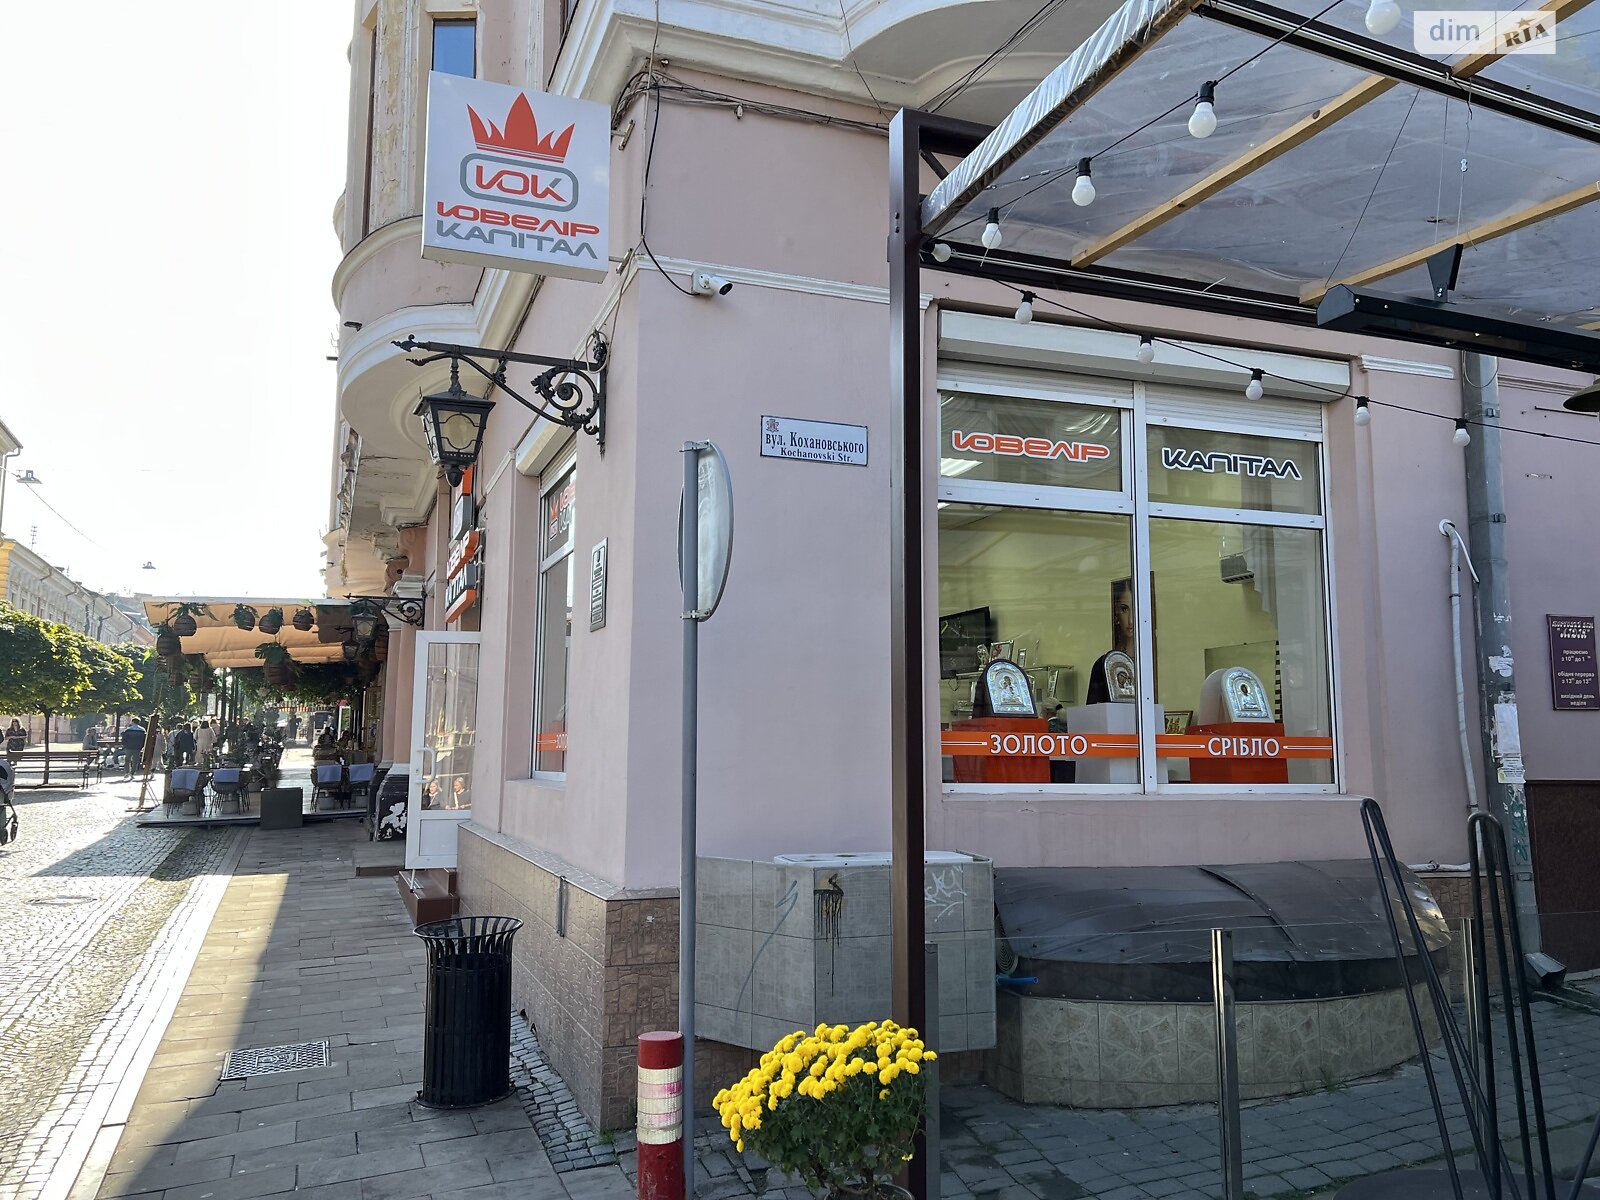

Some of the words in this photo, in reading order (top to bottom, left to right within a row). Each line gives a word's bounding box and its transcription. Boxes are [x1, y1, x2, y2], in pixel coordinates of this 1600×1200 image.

[436, 219, 598, 260] КАПІТАЛ
[766, 433, 786, 449] вул.
[790, 431, 864, 454] Кохановського
[781, 447, 835, 461] Kochanovski
[838, 453, 853, 463] Str.
[1161, 447, 1303, 481] КАПІТАЛ
[989, 733, 1089, 756] ЗОЛОТО
[1207, 737, 1280, 758] СРІБЛО
